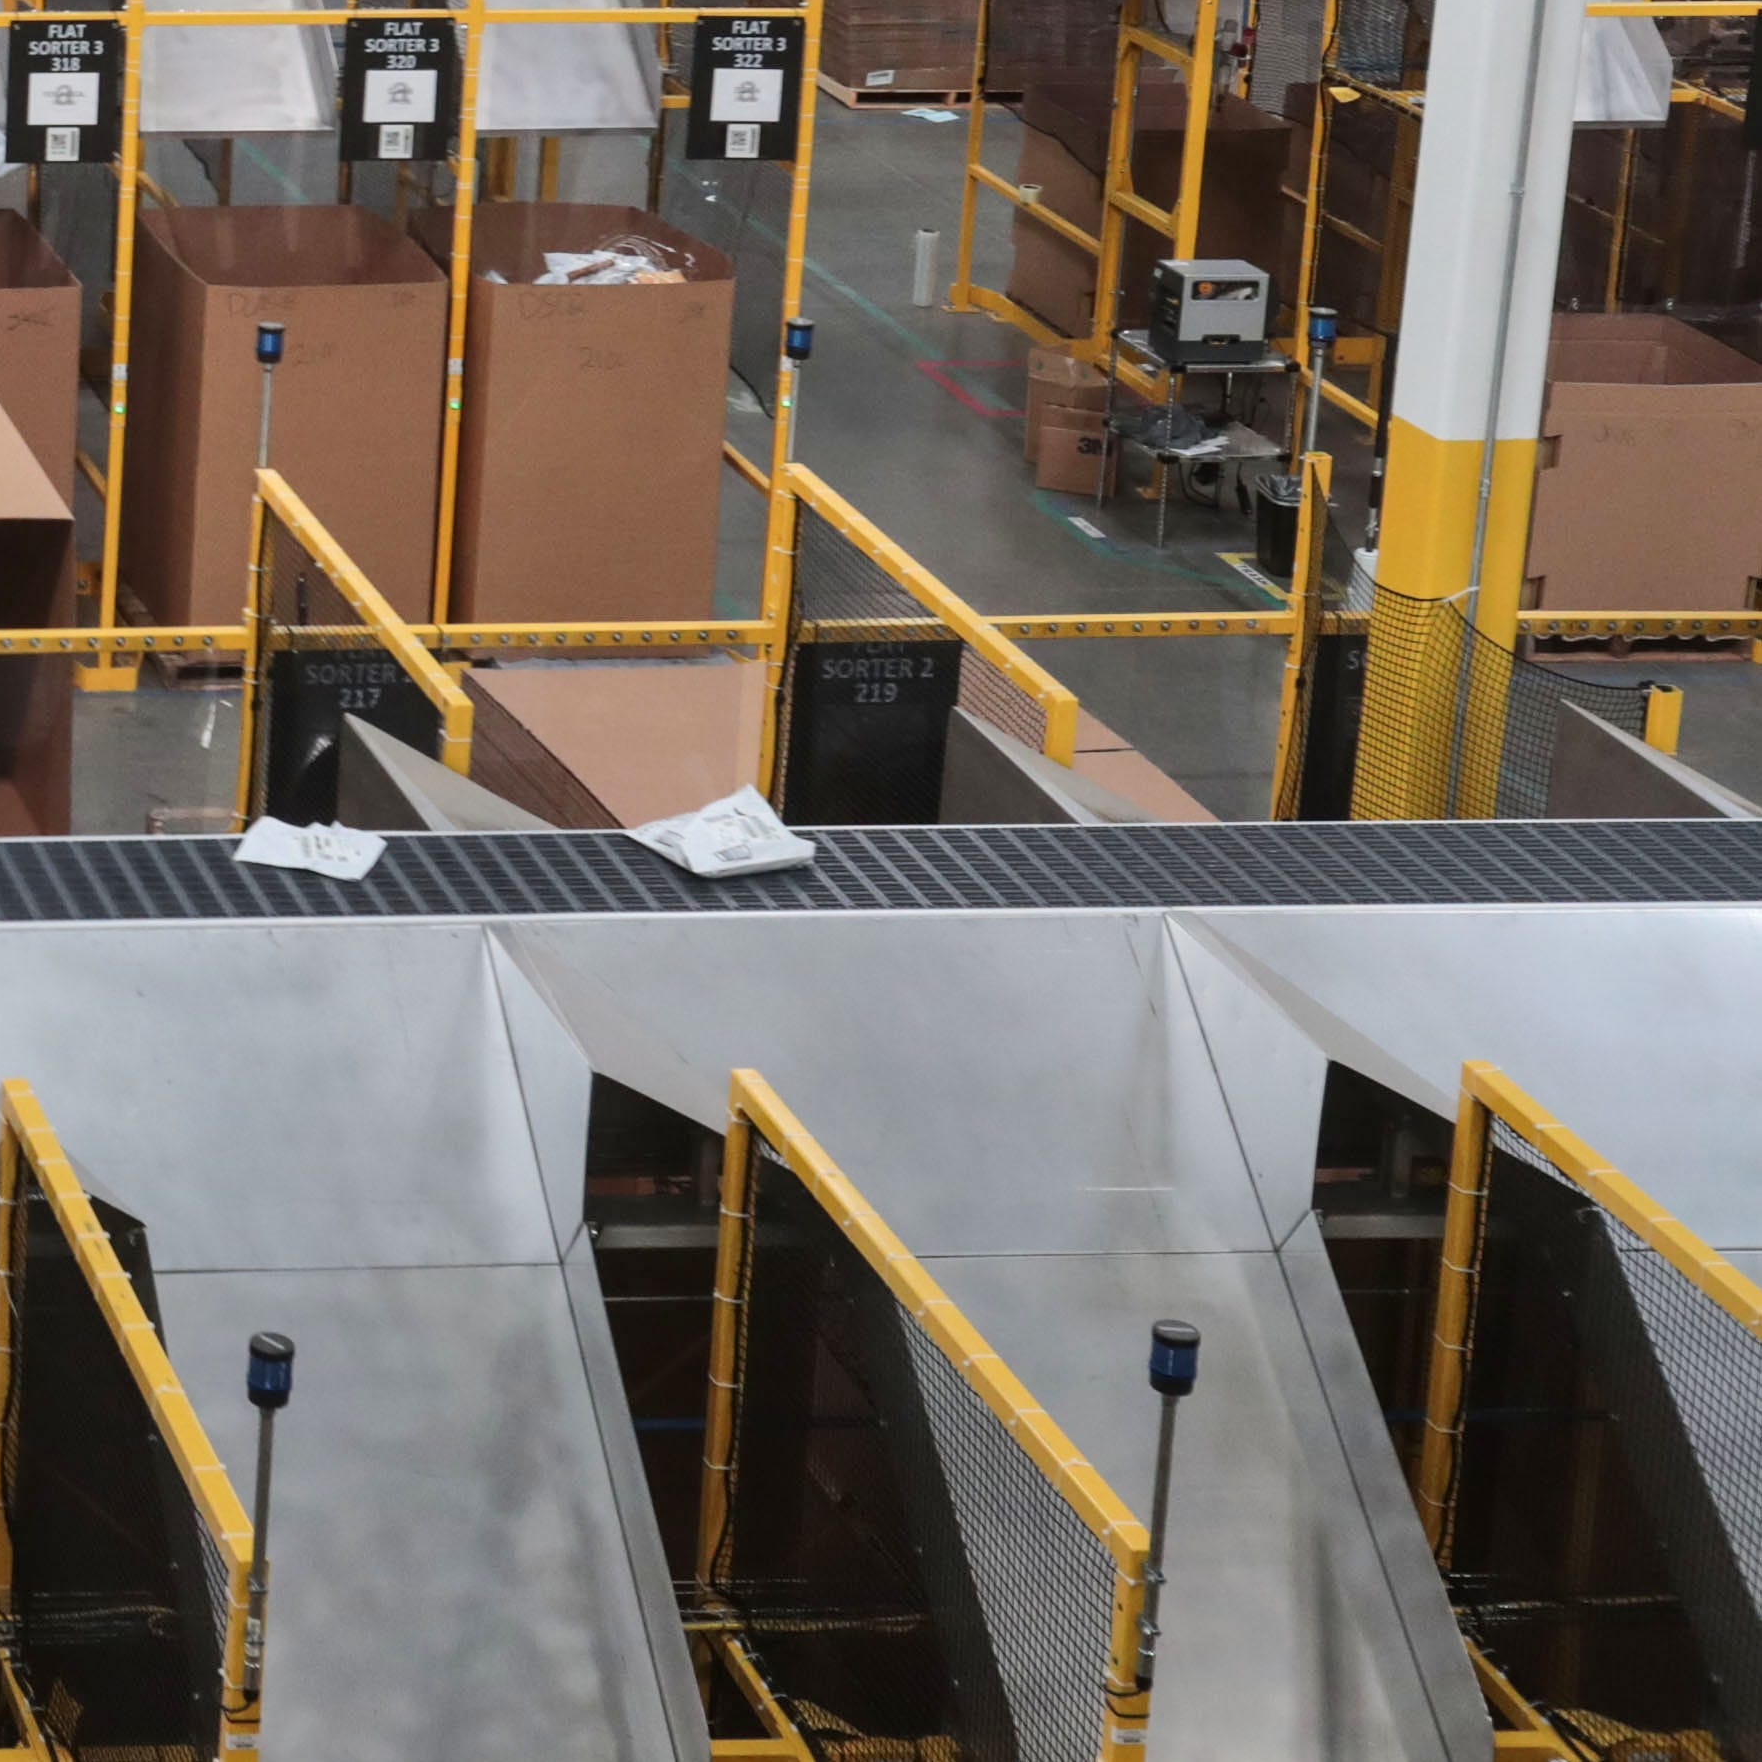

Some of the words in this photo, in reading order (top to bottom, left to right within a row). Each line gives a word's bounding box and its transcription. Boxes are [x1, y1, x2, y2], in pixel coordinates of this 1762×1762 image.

[48, 24, 87, 38] FLAT
[384, 22, 423, 36] FLAT
[732, 21, 771, 34] FLAT
[28, 41, 91, 55] SORTER
[93, 41, 104, 55] 3
[364, 38, 426, 52] SORTER
[428, 38, 440, 52] 3
[711, 37, 773, 51] SORTER
[776, 37, 787, 51] 3
[51, 58, 81, 71] 318
[386, 55, 417, 69] 320
[733, 54, 763, 68] 322
[305, 661, 397, 685] SORTER
[822, 657, 913, 681] SORTER
[921, 657, 935, 679] 2
[854, 681, 898, 705] 219
